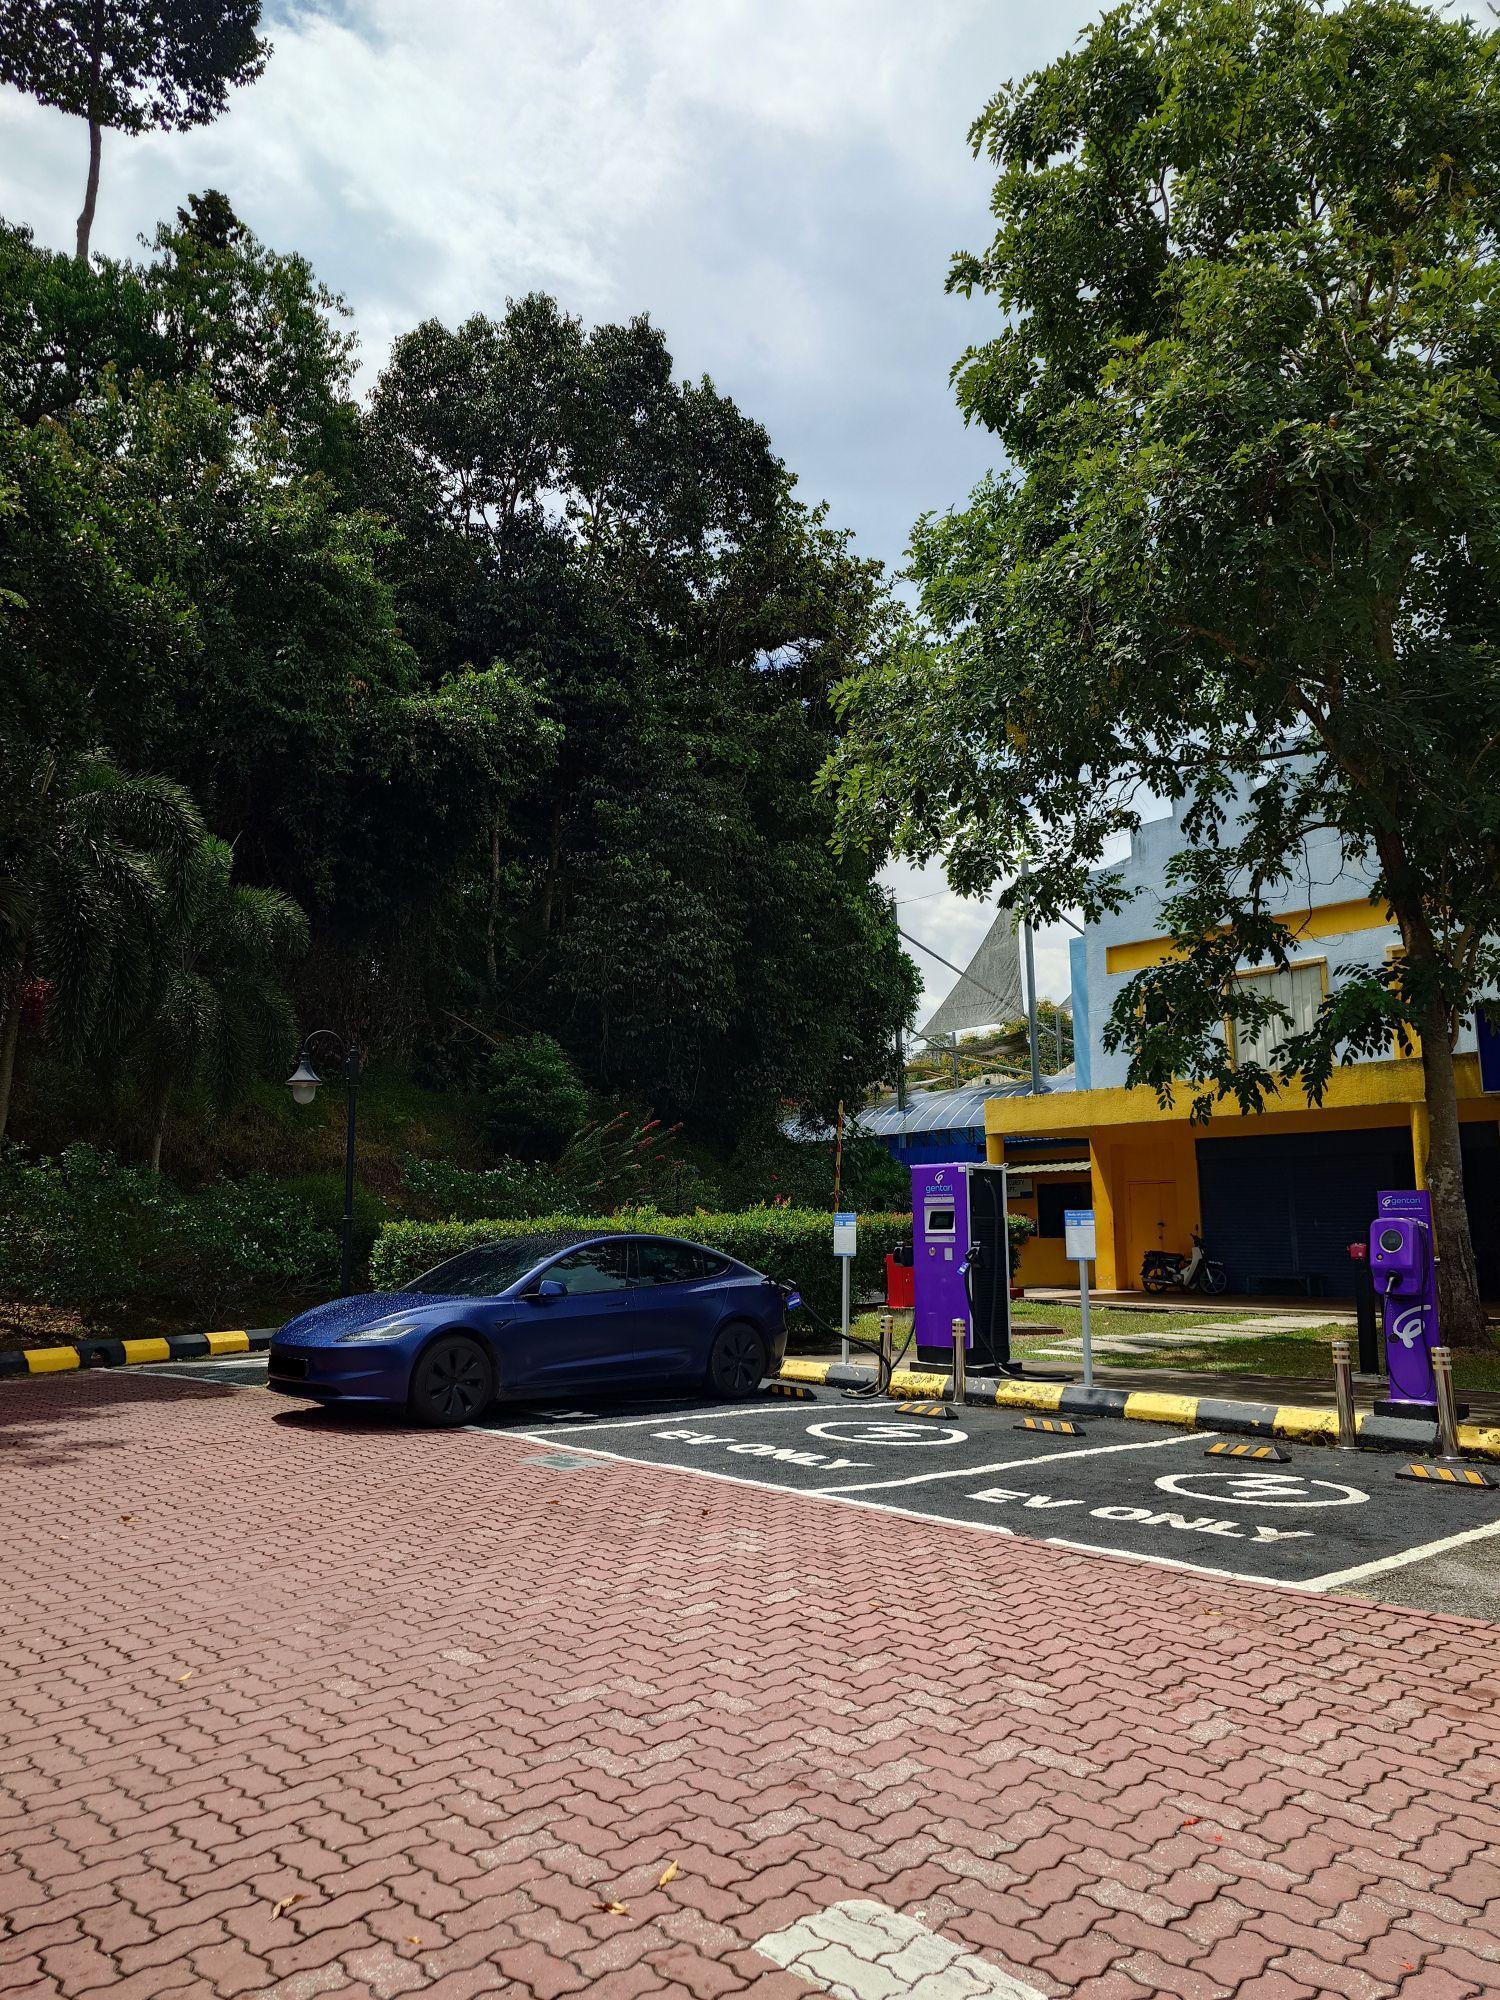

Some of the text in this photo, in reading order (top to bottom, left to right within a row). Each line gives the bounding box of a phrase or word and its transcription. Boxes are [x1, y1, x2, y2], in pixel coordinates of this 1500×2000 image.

[925, 1184, 953, 1193] gentari
[650, 1429, 876, 1470] EV ONLY
[964, 1487, 1317, 1543] EV ONLY
